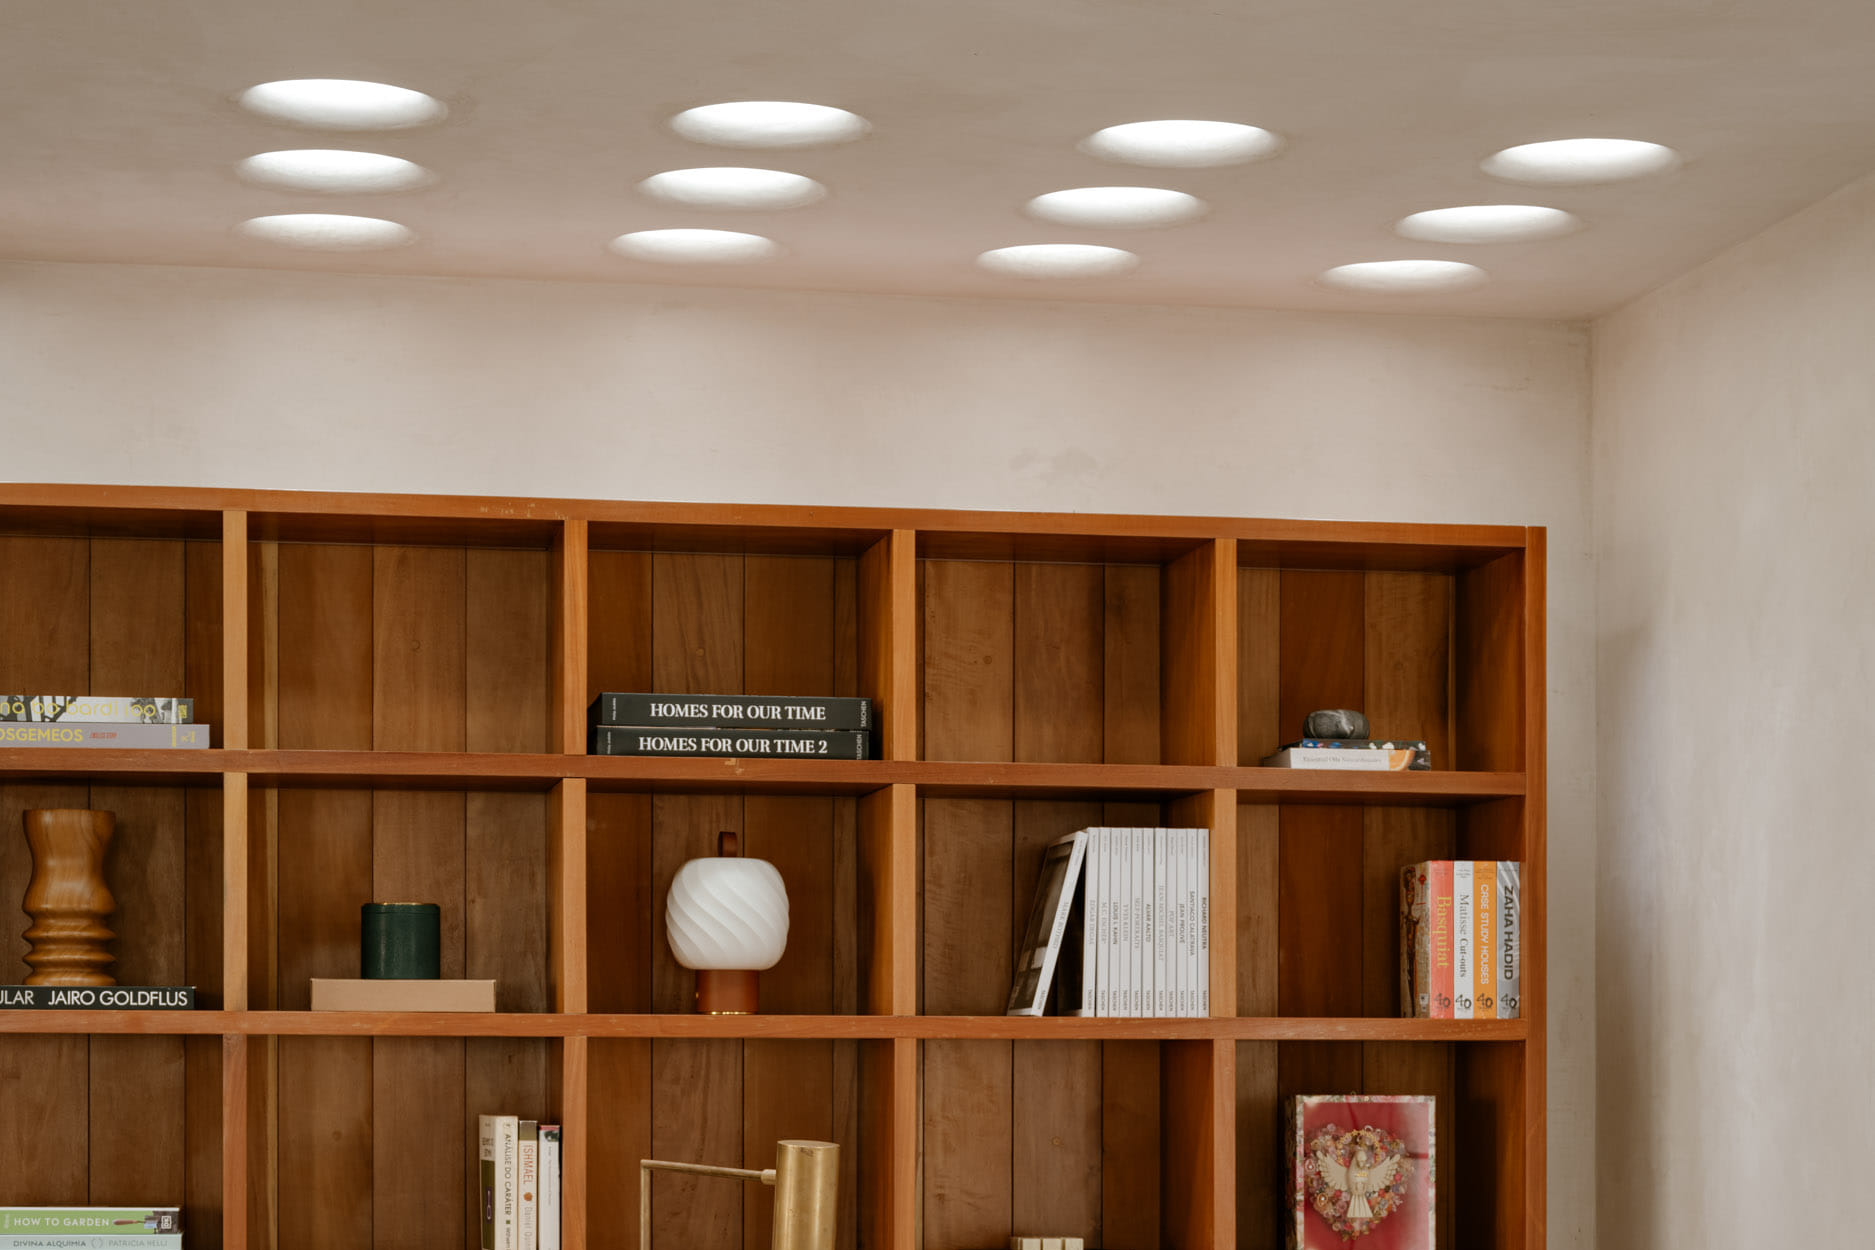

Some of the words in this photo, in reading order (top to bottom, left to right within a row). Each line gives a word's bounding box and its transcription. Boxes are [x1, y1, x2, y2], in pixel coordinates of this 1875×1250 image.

[32, 699, 58, 714] bo
[66, 699, 118, 716] bardi
[650, 703, 708, 718] HOMES
[712, 703, 744, 719] FOR
[746, 704, 782, 720] OUR
[784, 705, 827, 721] TIME
[860, 701, 868, 728] TASCHEN
[638, 736, 697, 752] HOMES
[700, 737, 733, 752] FOR
[735, 738, 772, 753] OUR
[773, 739, 815, 754] TIME
[818, 740, 828, 754] 2
[1480, 884, 1489, 909] CASE
[1504, 885, 1514, 930] ZAHA
[1459, 894, 1470, 935] Matisse
[1432, 895, 1452, 968] Basquiat
[1480, 911, 1489, 944] STUDY
[1459, 938, 1469, 978] Cut-outs
[1480, 945, 1489, 985] HOUSES
[1504, 931, 1514, 980] HADID
[48, 990, 96, 1006] JAIRO
[99, 990, 188, 1007] GOLDFLUS
[1455, 994, 1472, 1010] 40
[1476, 993, 1494, 1009] 40
[1500, 993, 1518, 1010] 40
[504, 1167, 512, 1179] DO
[523, 1144, 534, 1185] ISHMAEL
[504, 1181, 514, 1216] CARÁTER
[14, 1217, 41, 1227] HOW
[45, 1217, 60, 1227] TO
[63, 1217, 110, 1227] GARDEN
[13, 1240, 44, 1248] DIVINA
[46, 1240, 87, 1248] ALQUIMIA
